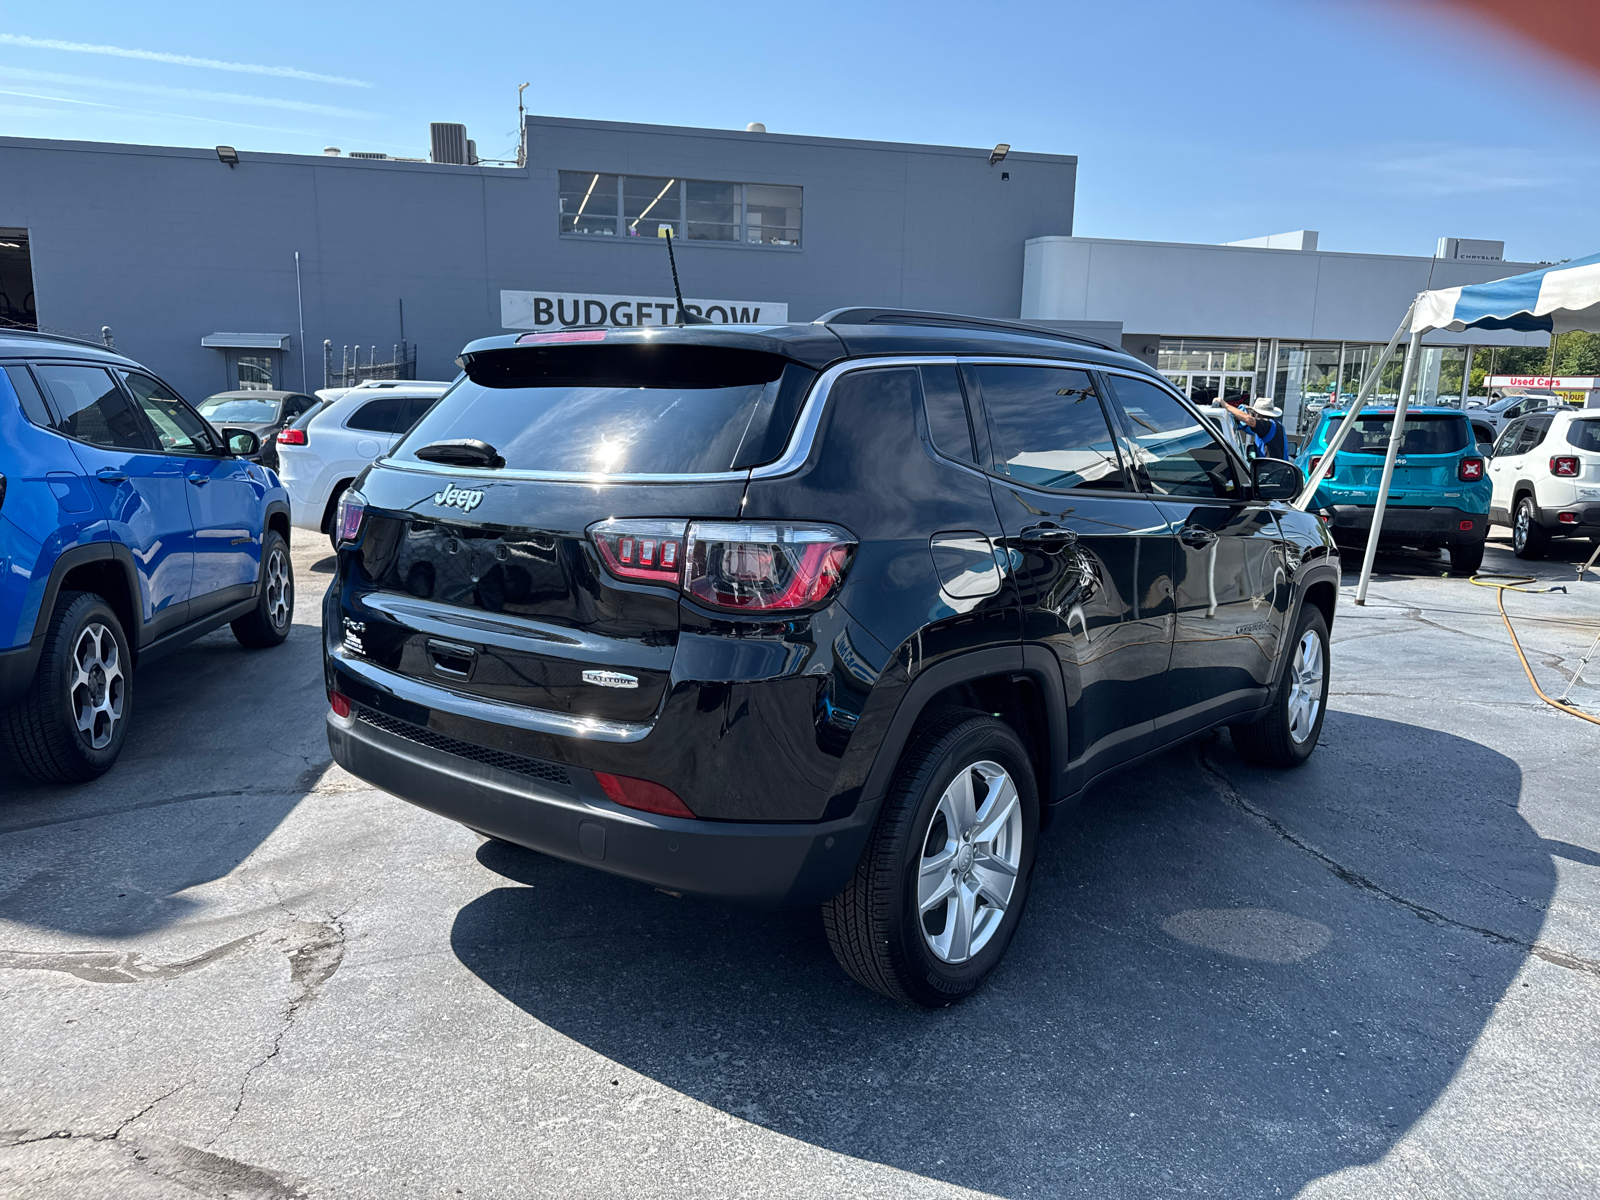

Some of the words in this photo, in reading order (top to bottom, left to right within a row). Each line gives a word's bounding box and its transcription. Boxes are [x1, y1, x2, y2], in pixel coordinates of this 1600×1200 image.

[533, 297, 674, 326] BUDGET
[1510, 377, 1535, 386] Used
[1537, 378, 1561, 387] Cars
[434, 482, 484, 513] Jeep
[587, 674, 633, 684] LATITUDE
